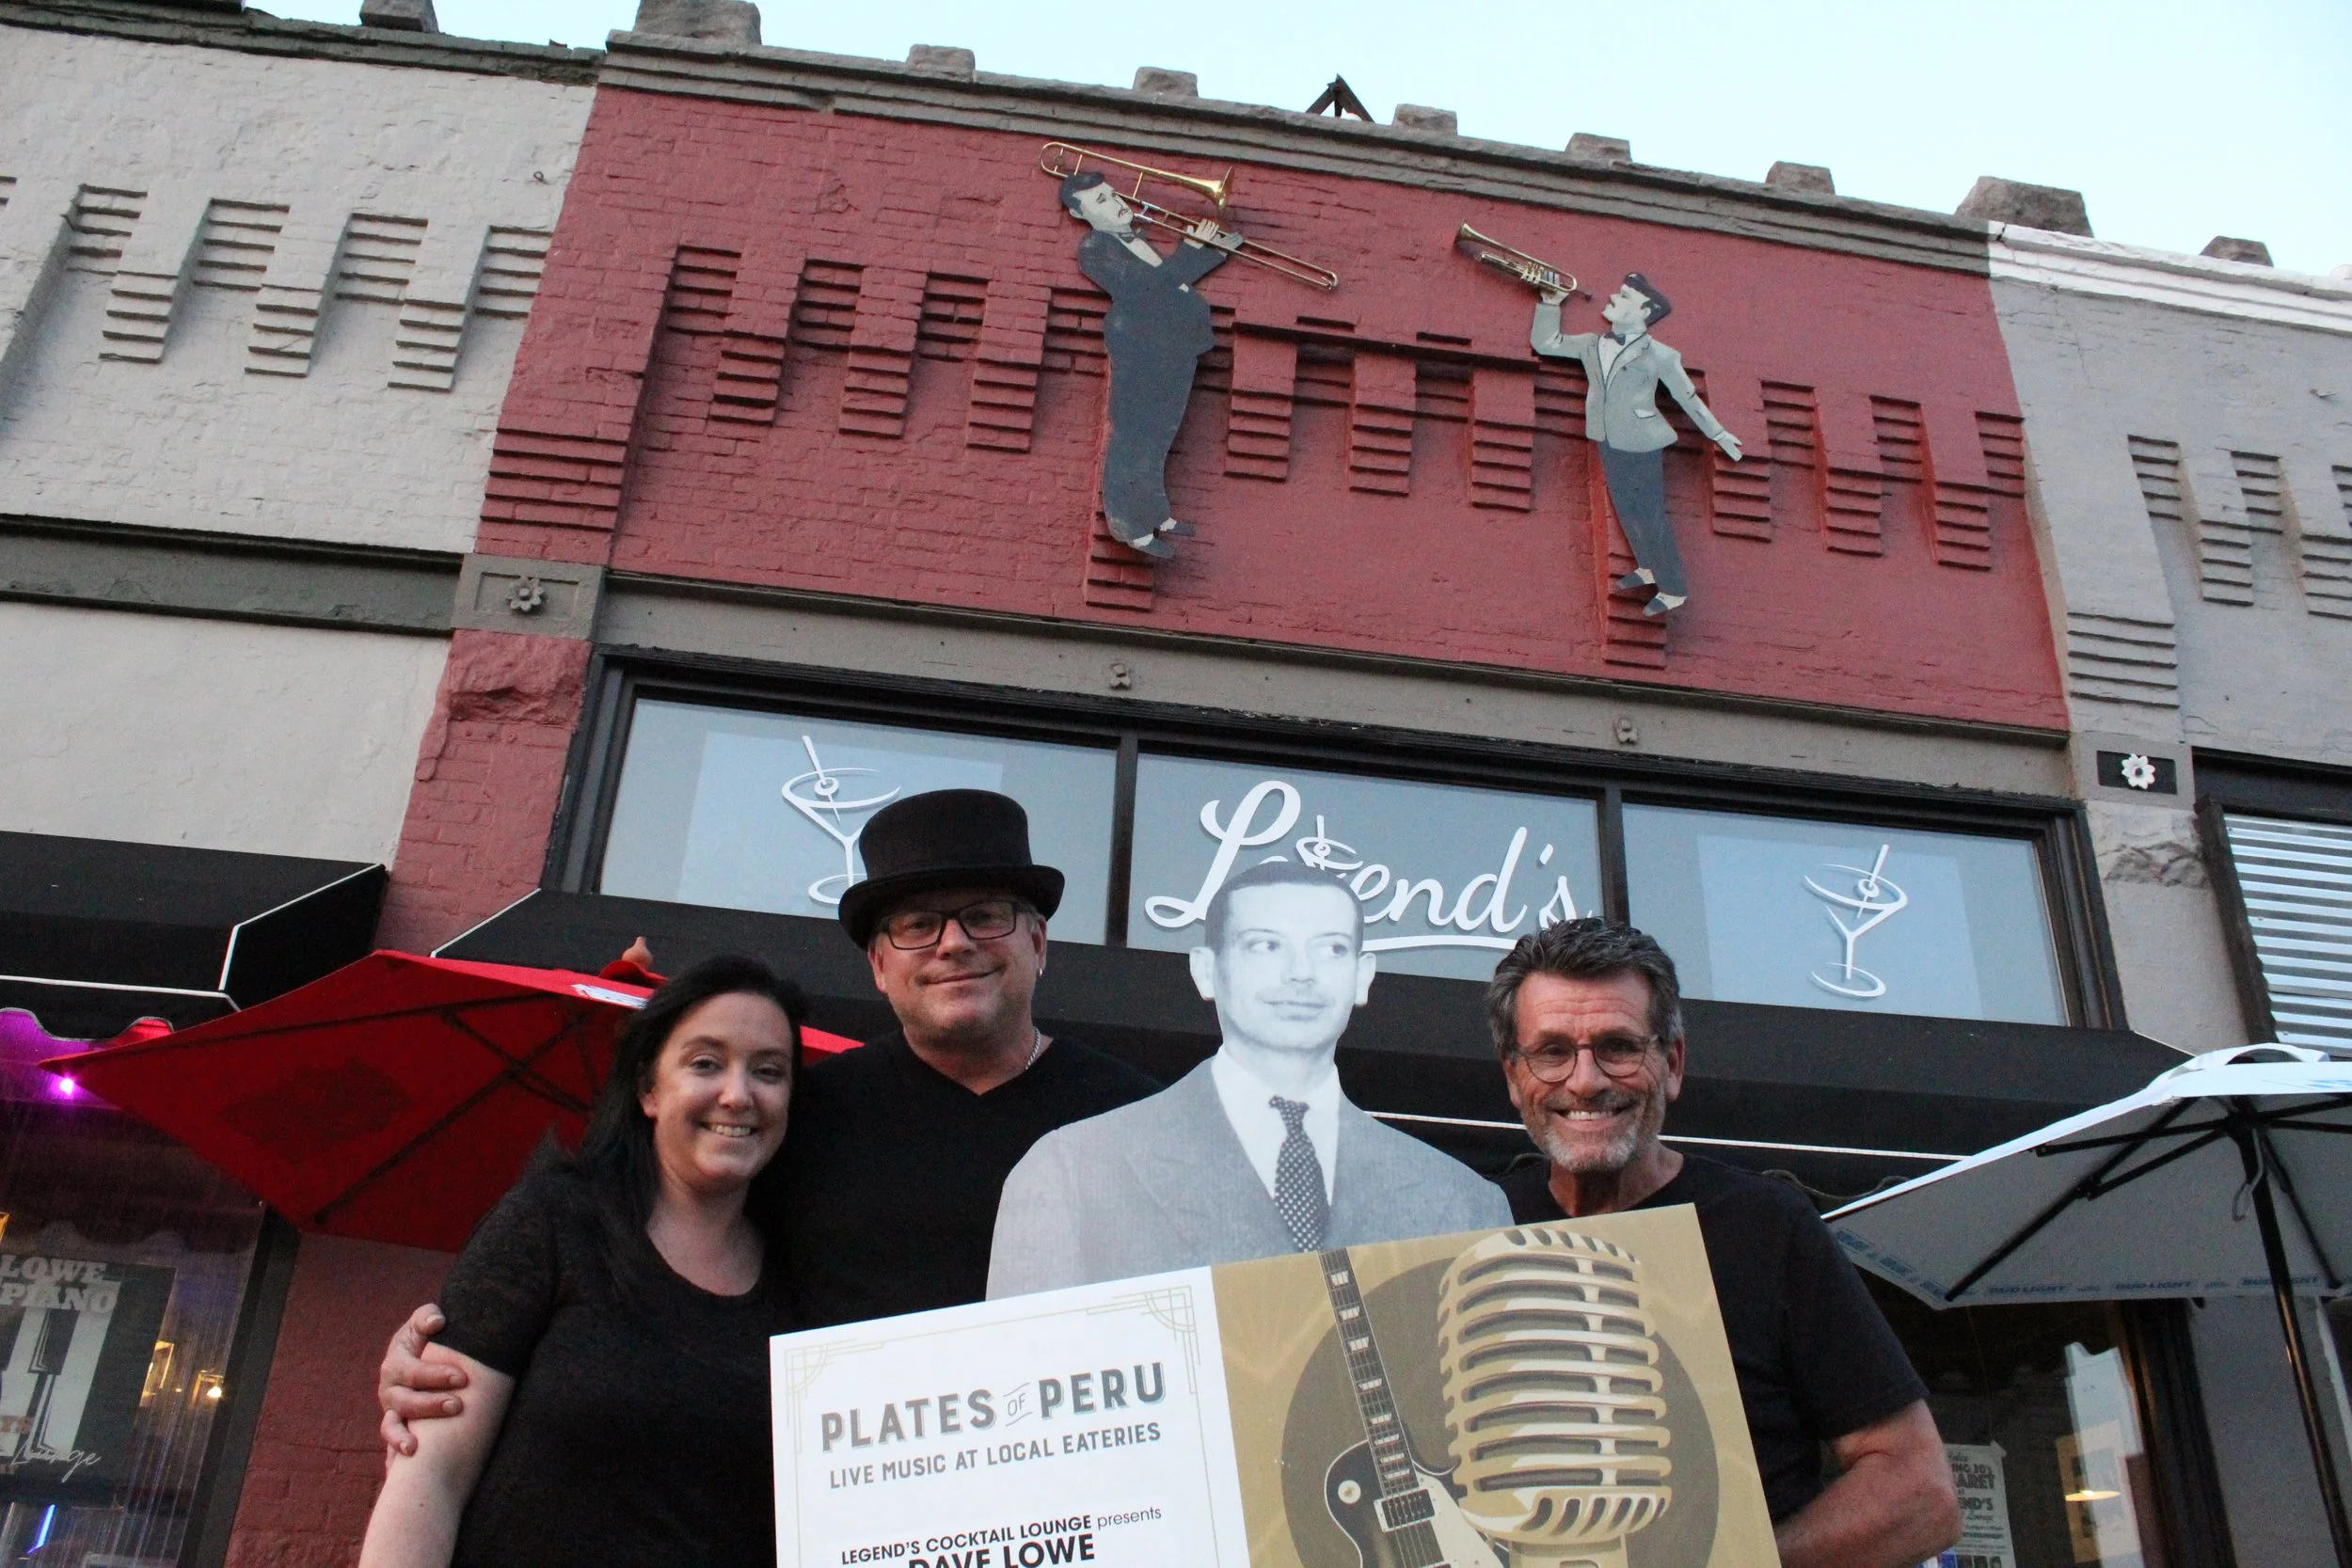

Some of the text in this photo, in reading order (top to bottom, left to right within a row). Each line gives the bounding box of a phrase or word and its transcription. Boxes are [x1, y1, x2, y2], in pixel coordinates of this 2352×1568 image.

[1144, 780, 1592, 932] Lend's
[0, 1254, 108, 1283] LOWE
[0, 1282, 121, 1313] PIANO
[821, 1362, 1166, 1452] PLATES OF PERU
[830, 1422, 1161, 1489] LIVE MUSIC AT LOCAL EATERIES
[842, 1507, 1162, 1565] LEGEND'S COCKTAIL LOUNGE presents
[1003, 1533, 1095, 1568] LOWE
